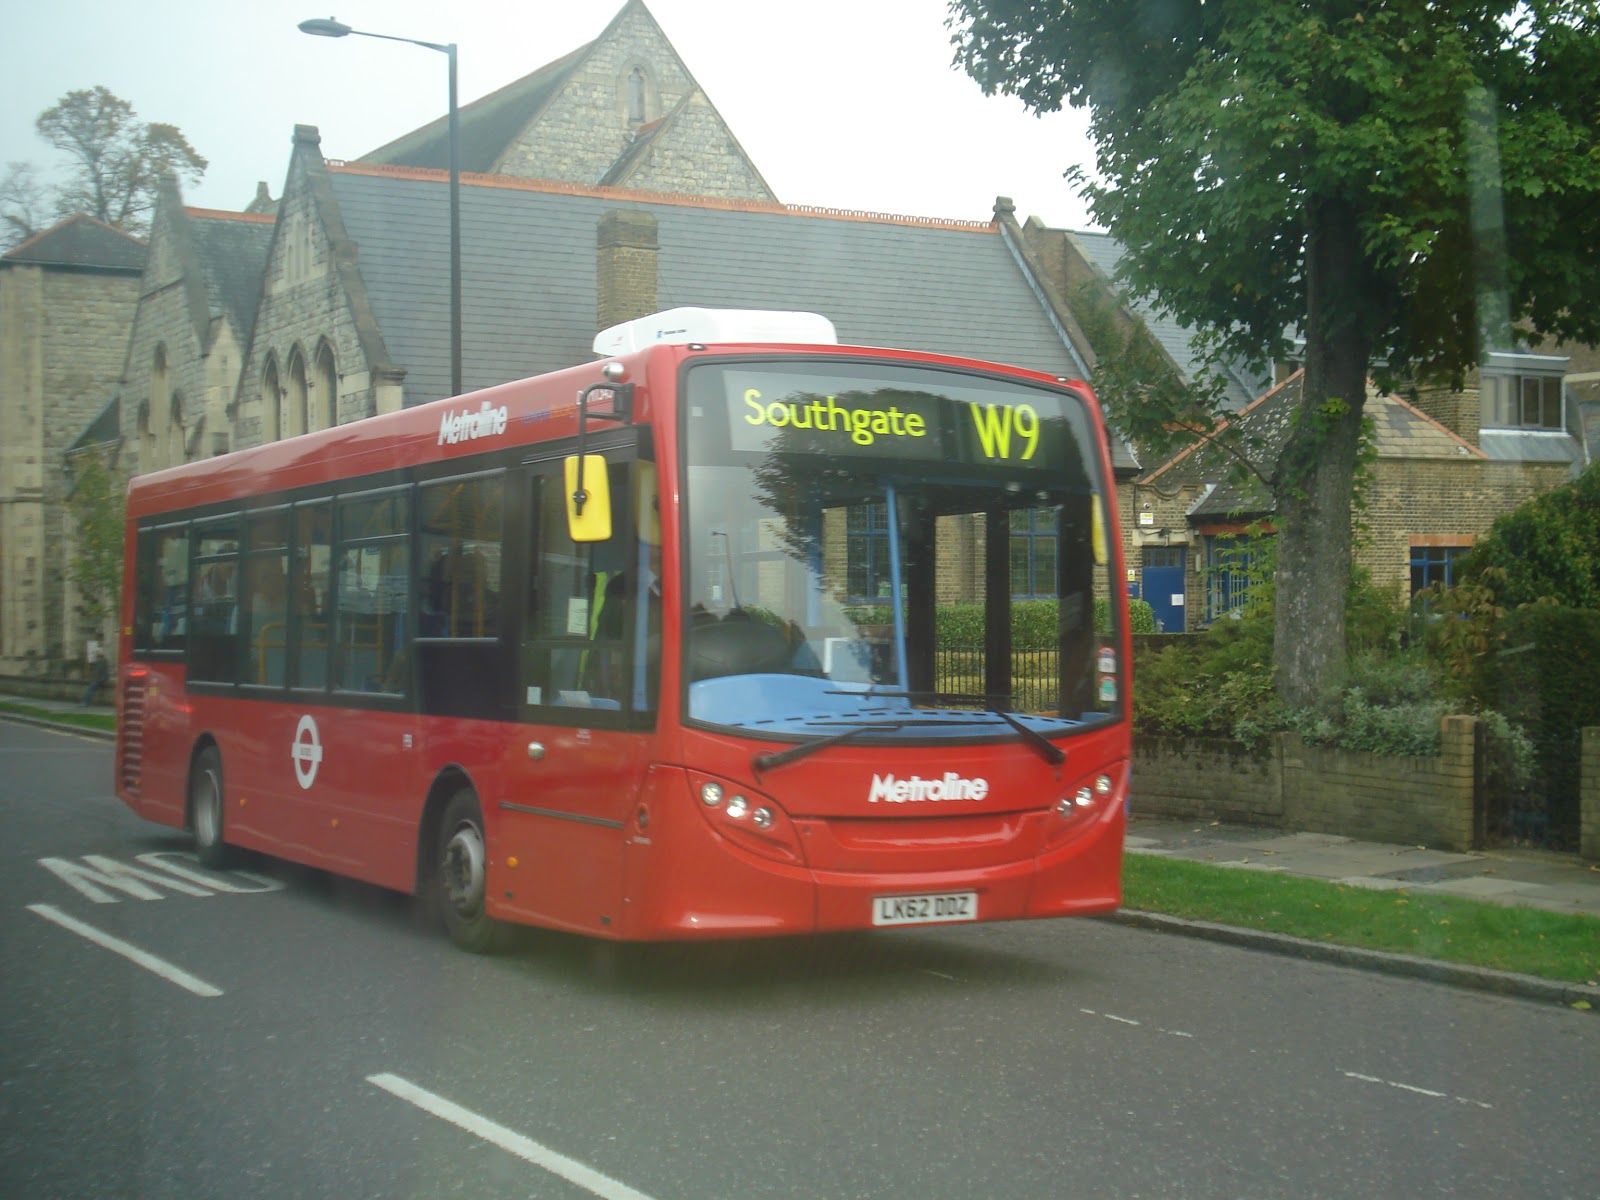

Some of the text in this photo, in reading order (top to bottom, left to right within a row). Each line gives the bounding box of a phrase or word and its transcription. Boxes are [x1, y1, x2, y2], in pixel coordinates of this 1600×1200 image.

[437, 401, 508, 446] Metroline
[743, 388, 1039, 460] Southgate W9
[868, 771, 989, 803] Metroline
[882, 896, 969, 920] LK62 DDZ
